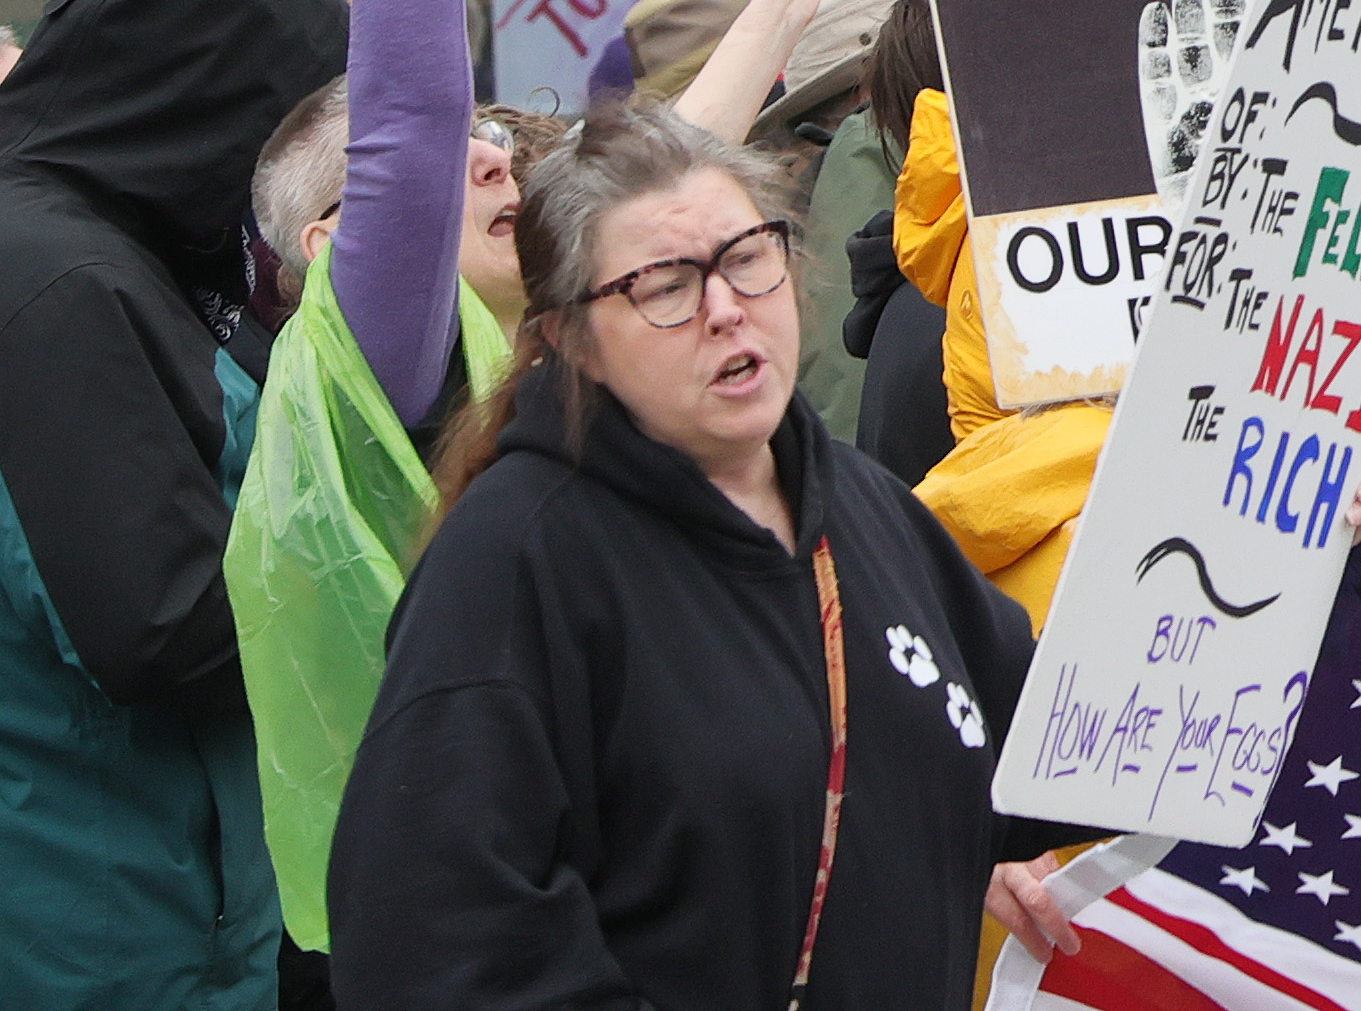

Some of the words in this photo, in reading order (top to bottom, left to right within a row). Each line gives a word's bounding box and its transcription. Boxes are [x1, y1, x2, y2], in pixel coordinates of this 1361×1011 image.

[1005, 214, 1172, 292] OUR
[1222, 417, 1353, 549] RICH
[1147, 614, 1217, 664] BUT
